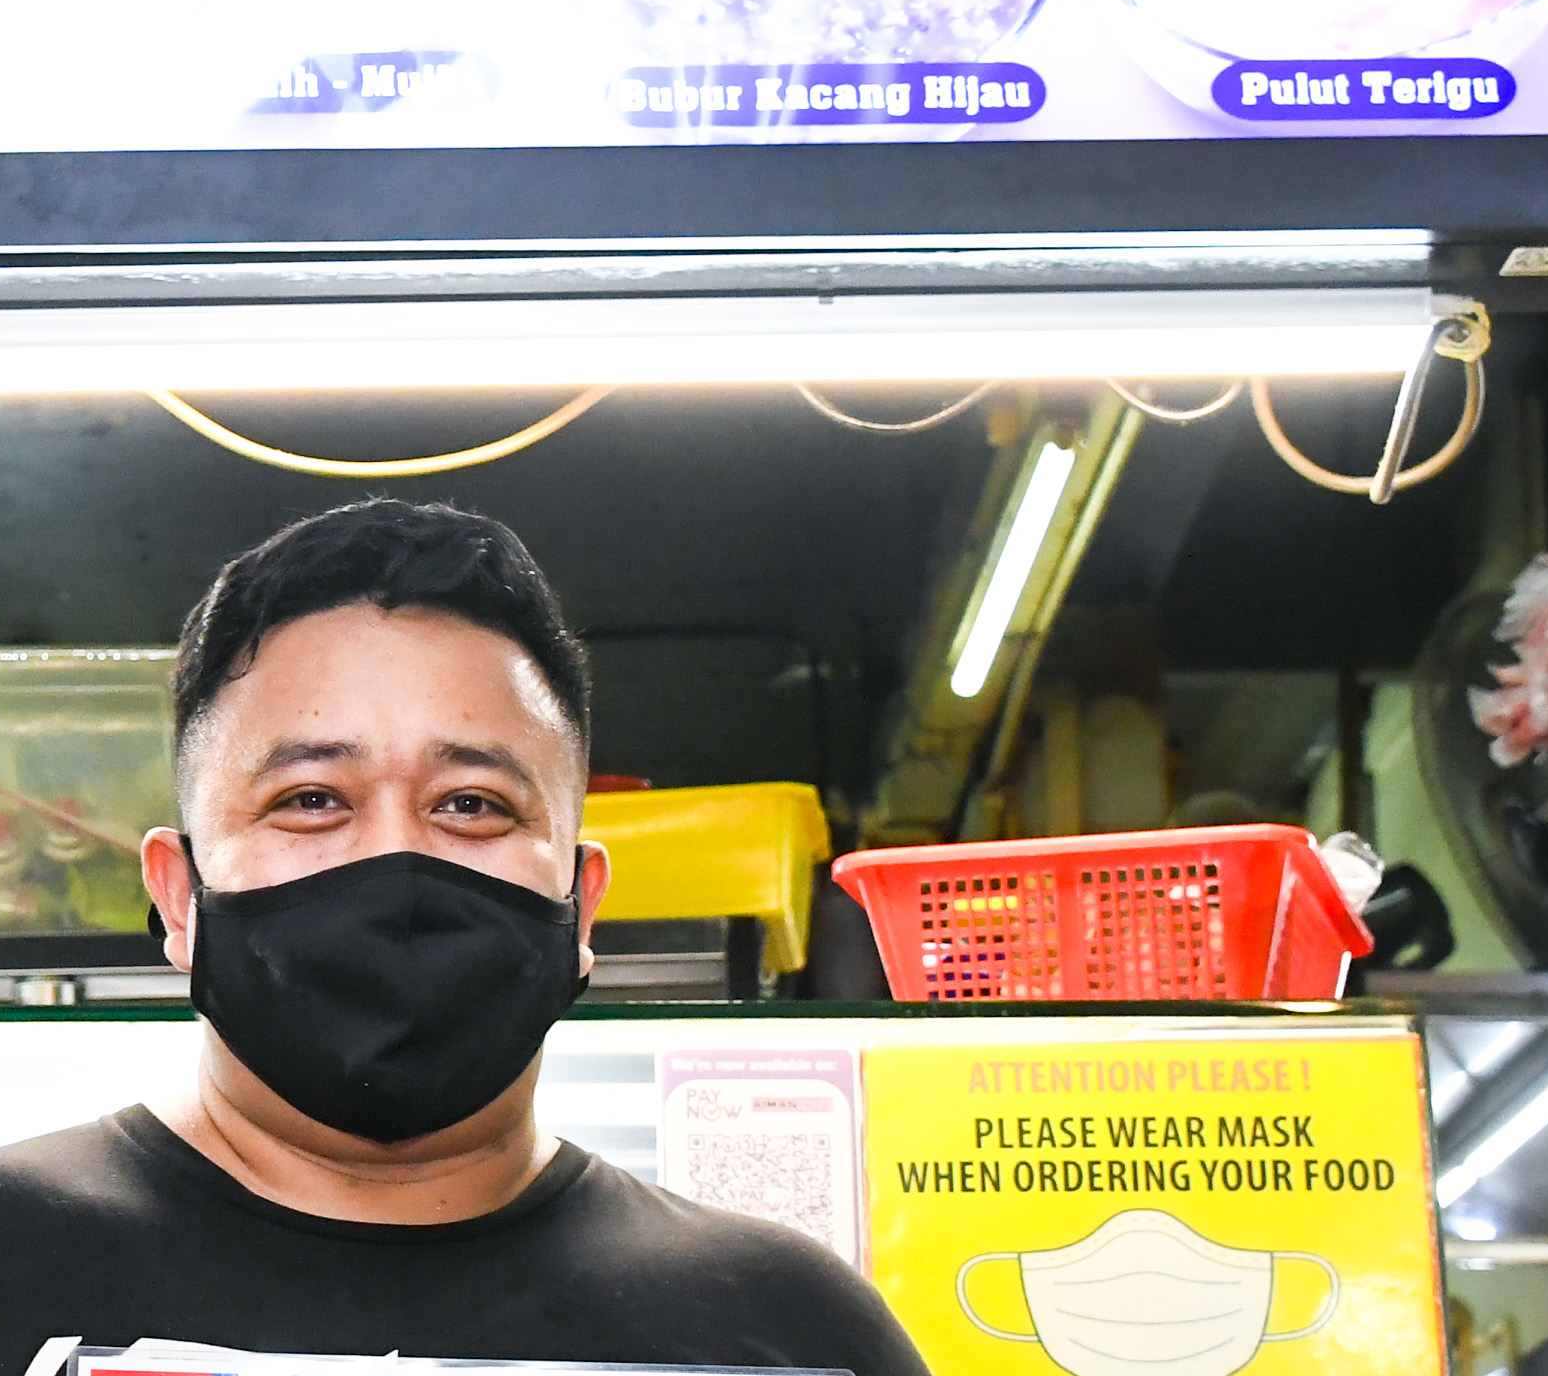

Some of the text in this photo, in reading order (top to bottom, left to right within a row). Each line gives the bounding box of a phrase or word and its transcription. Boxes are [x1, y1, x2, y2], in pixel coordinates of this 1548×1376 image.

[619, 75, 1031, 117] Bubur Kacang Hijau
[1240, 70, 1500, 111] Pulut Terigu
[969, 1060, 1155, 1094] ATTENTION
[1168, 1059, 1292, 1093] PLEASE
[686, 1089, 721, 1102] PAY
[974, 1115, 1314, 1148] PLEASE WEAR MASK
[897, 1159, 1395, 1193] WHEN ORDERING YOUR FOOD
